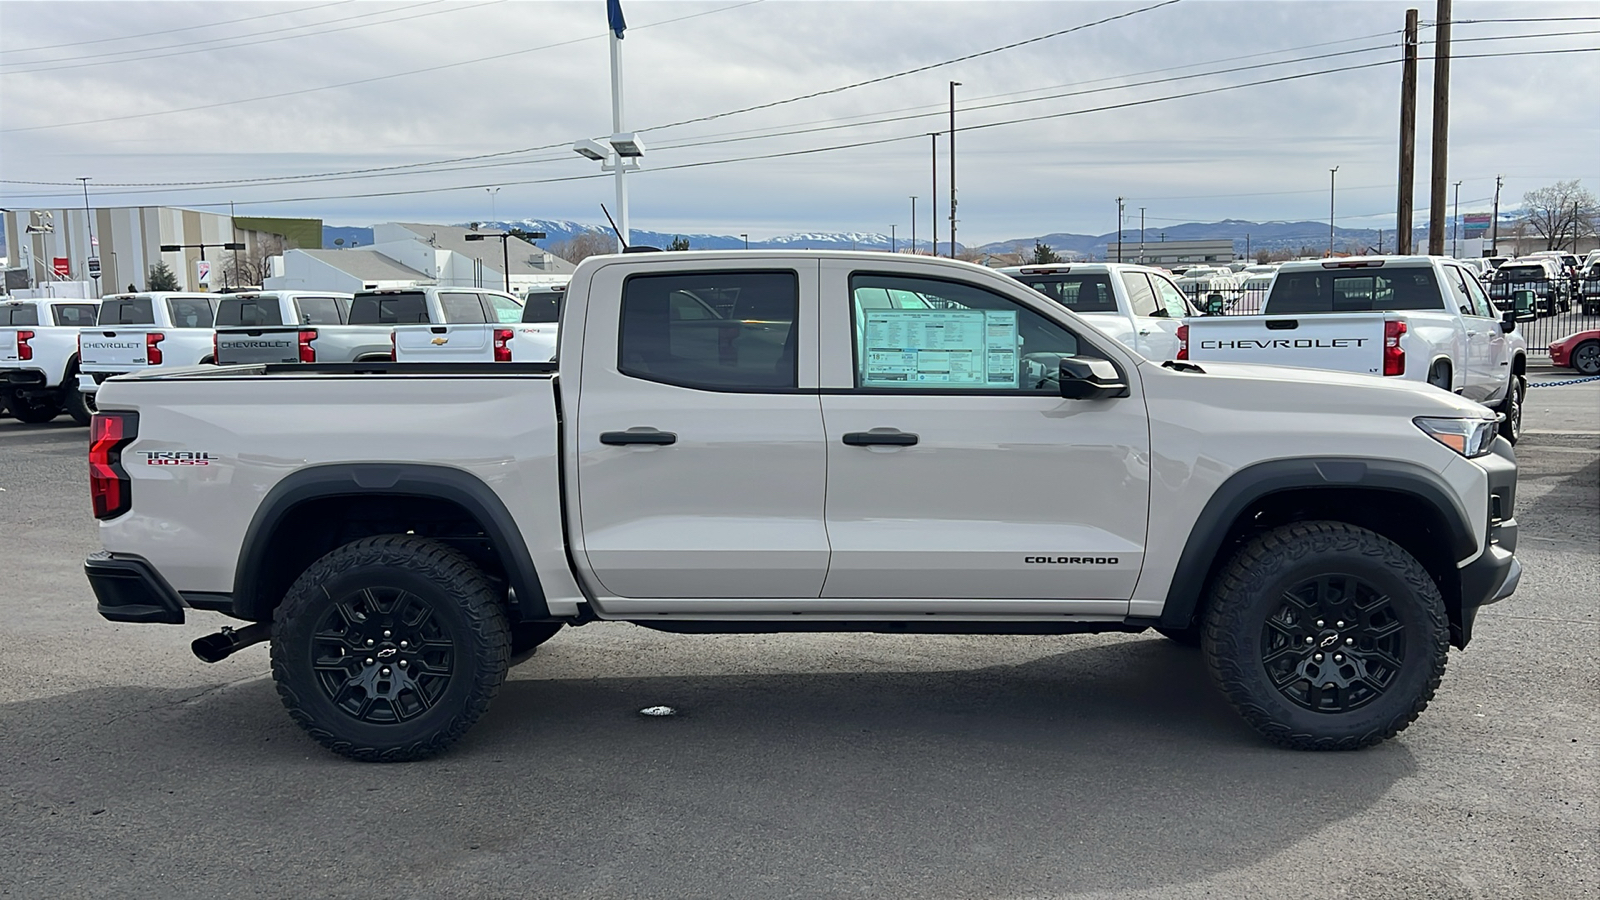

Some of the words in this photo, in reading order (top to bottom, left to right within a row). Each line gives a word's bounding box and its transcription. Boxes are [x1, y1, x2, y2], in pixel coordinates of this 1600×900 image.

[221, 341, 292, 349] CHEVROLET
[1201, 338, 1369, 349] CHEVROLET
[137, 452, 218, 460] TRAIL
[1025, 556, 1119, 565] COLORADO
